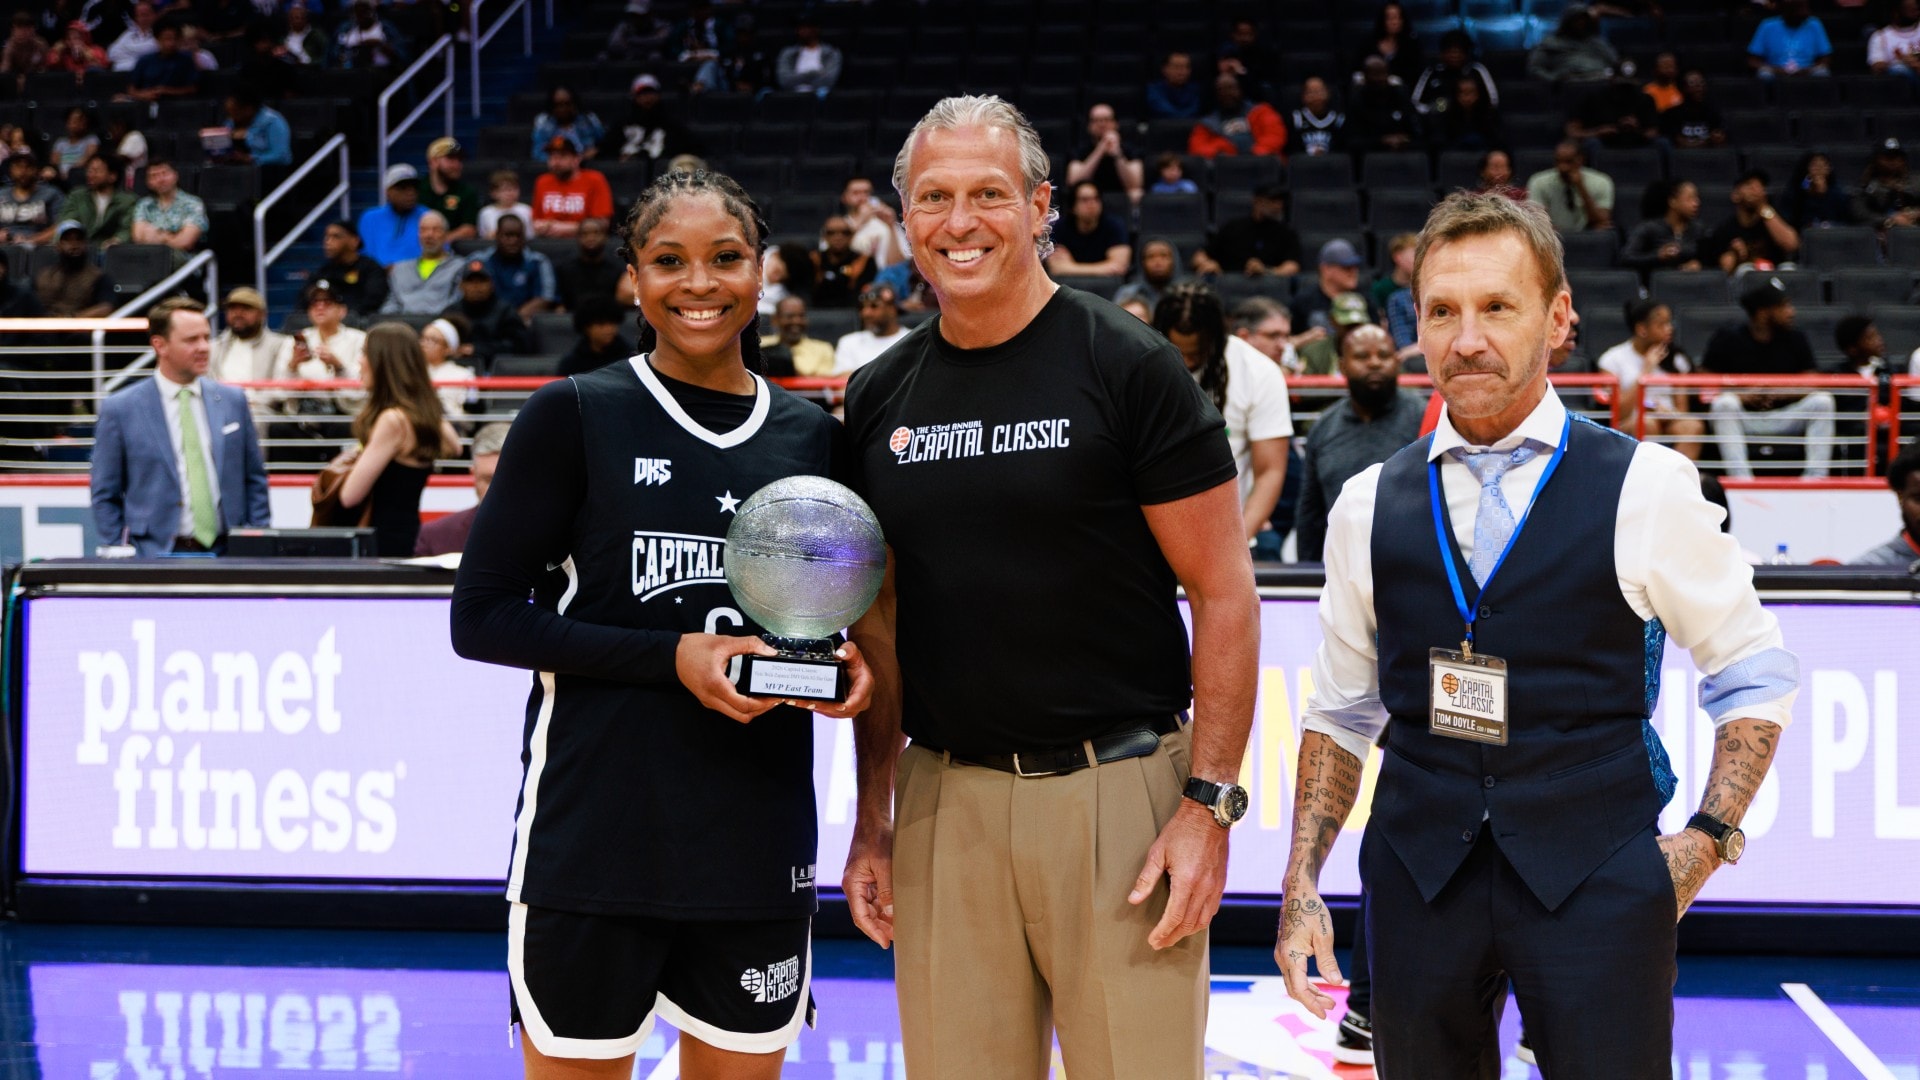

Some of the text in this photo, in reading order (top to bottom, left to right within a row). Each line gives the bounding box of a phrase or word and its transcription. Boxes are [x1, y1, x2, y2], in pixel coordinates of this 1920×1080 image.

[912, 418, 1070, 462] CAPITAL CLASSIC
[916, 420, 983, 434] THE 53rd ANNUAL
[634, 457, 672, 486] DKS
[632, 537, 724, 596] CAPITAL
[76, 619, 342, 765] planet
[764, 682, 824, 694] MVP East Team
[1462, 680, 1495, 700] CAPITAL
[1461, 694, 1494, 715] CLASSIC
[1436, 712, 1451, 726] TOM
[1453, 715, 1476, 731] DOYLE
[112, 734, 398, 853] fitness
[767, 957, 799, 986] CAPITAL
[767, 975, 799, 1003] CLASSIC
